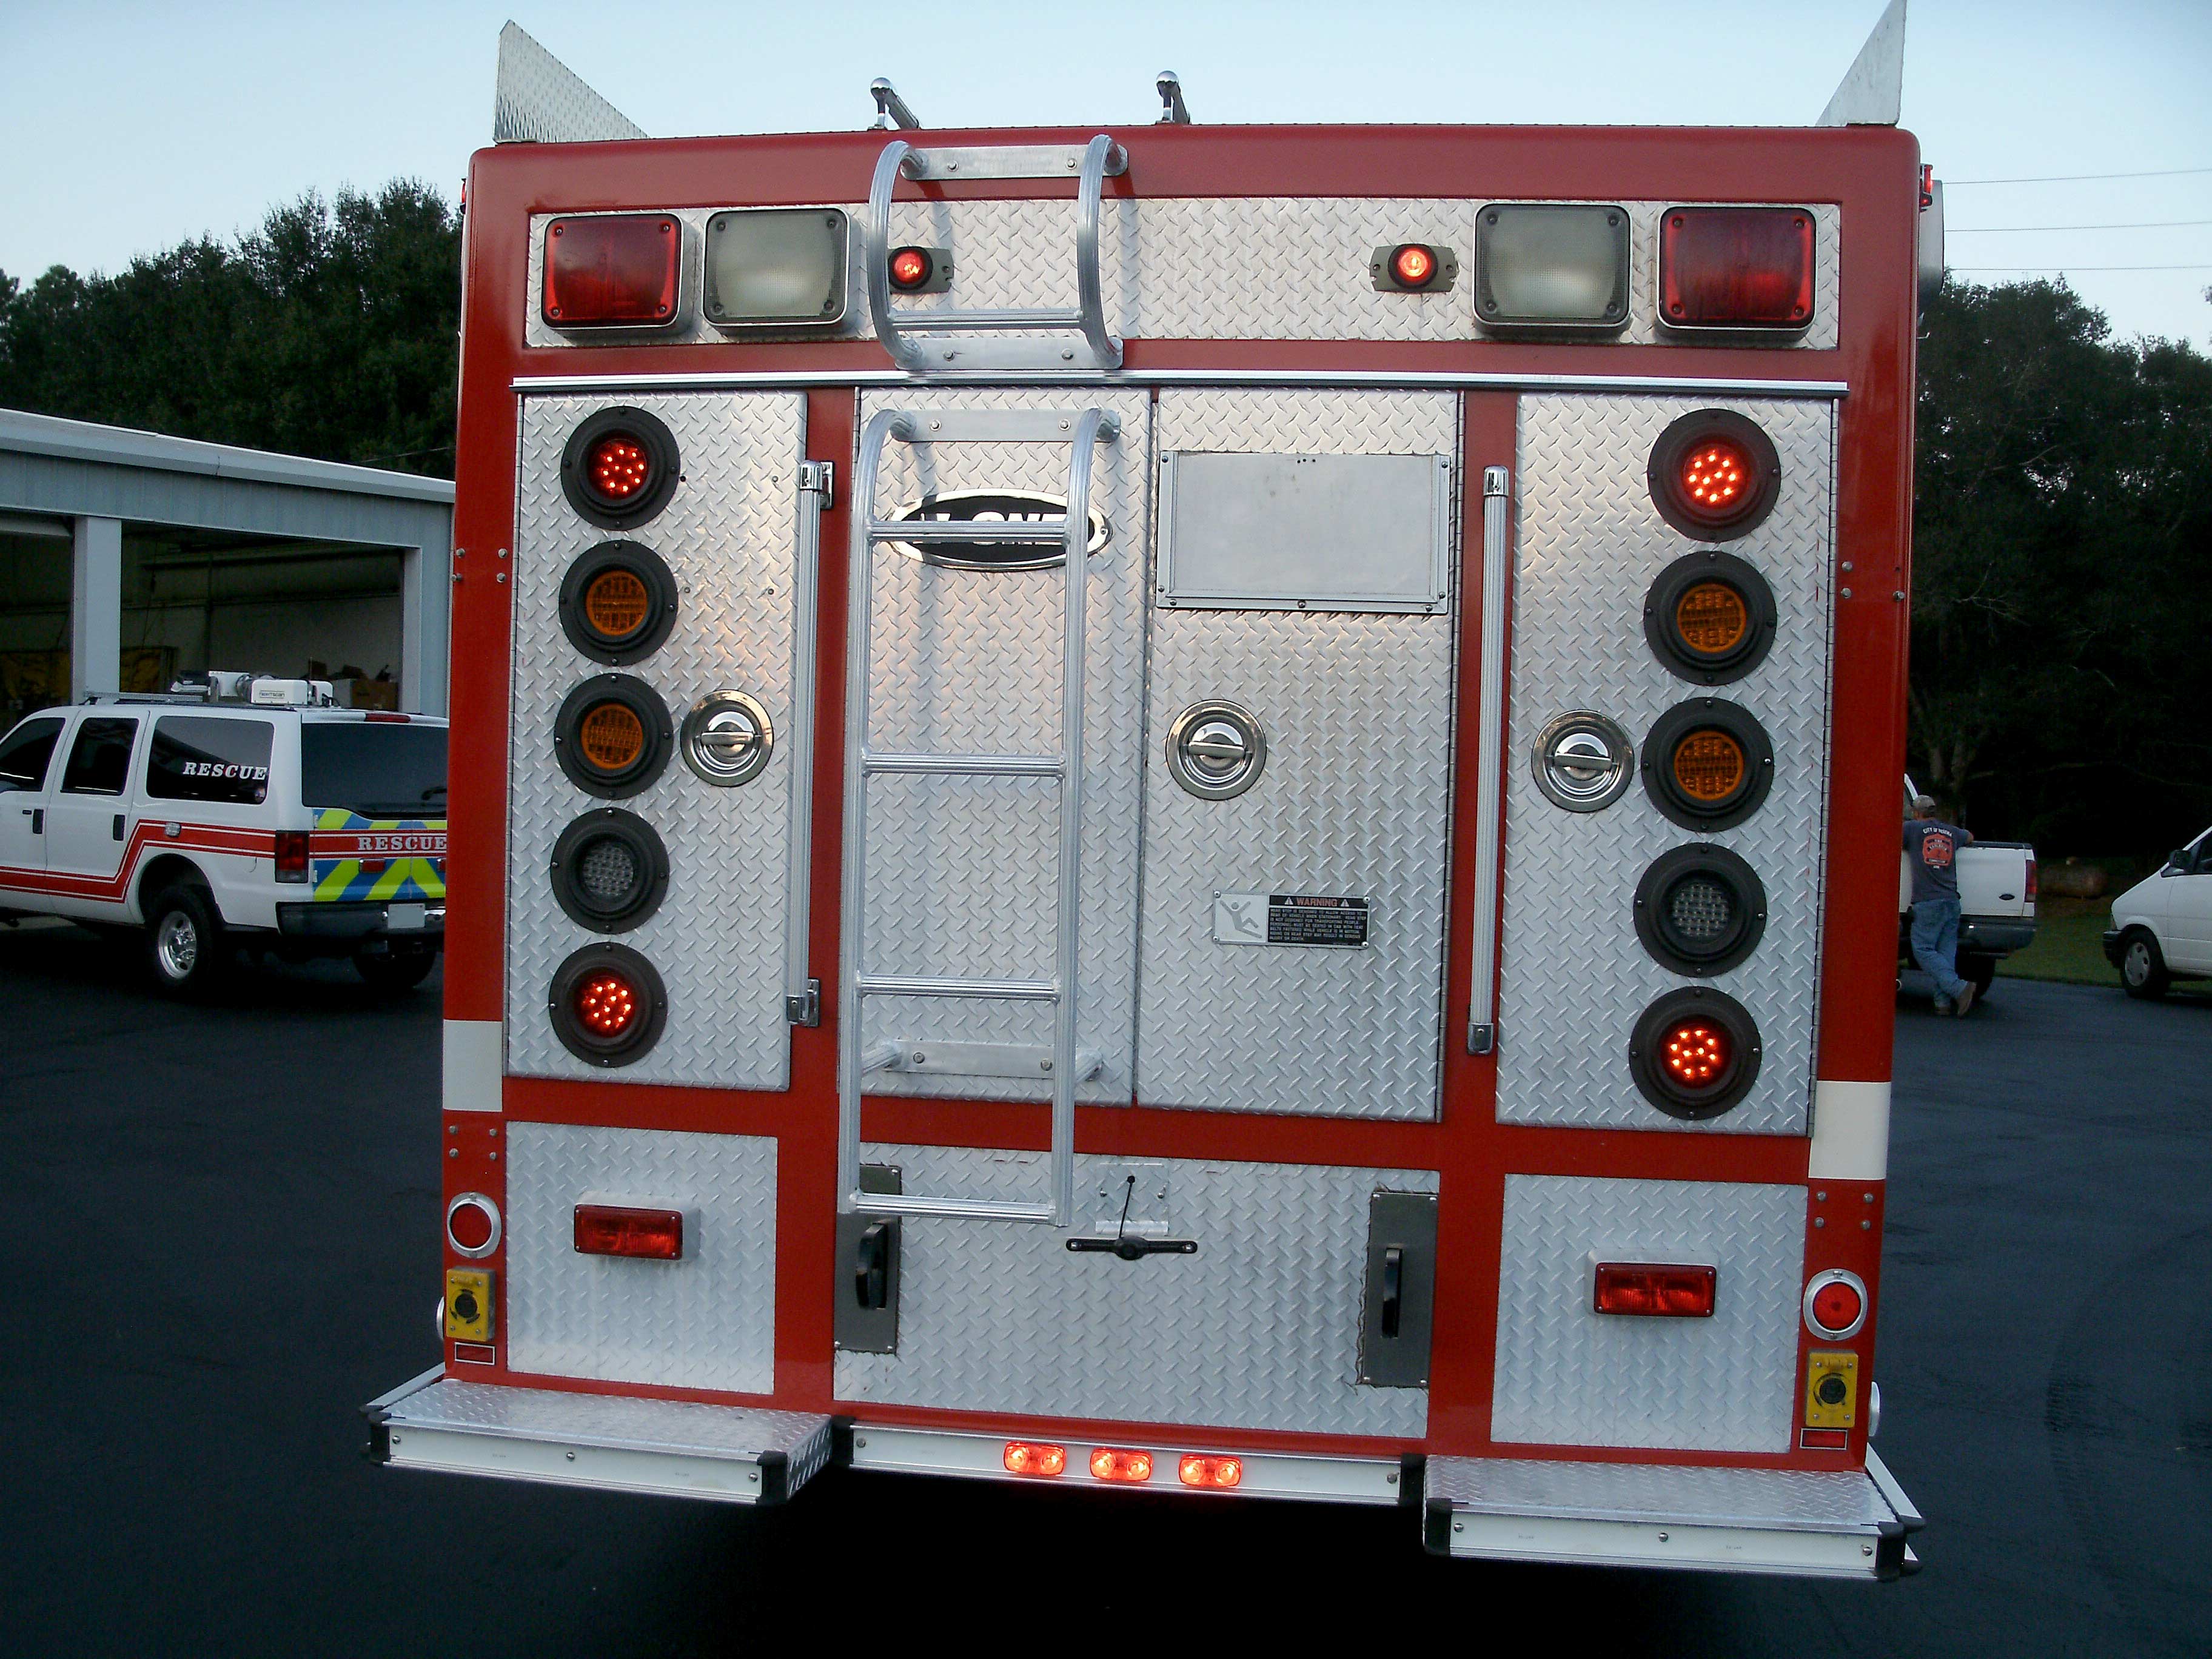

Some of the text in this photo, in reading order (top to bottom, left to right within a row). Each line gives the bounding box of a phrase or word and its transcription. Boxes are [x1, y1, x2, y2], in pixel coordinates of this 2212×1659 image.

[183, 762, 267, 780] RESCUE
[358, 837, 447, 851] RESCUE
[1296, 897, 1338, 907] WARNING
